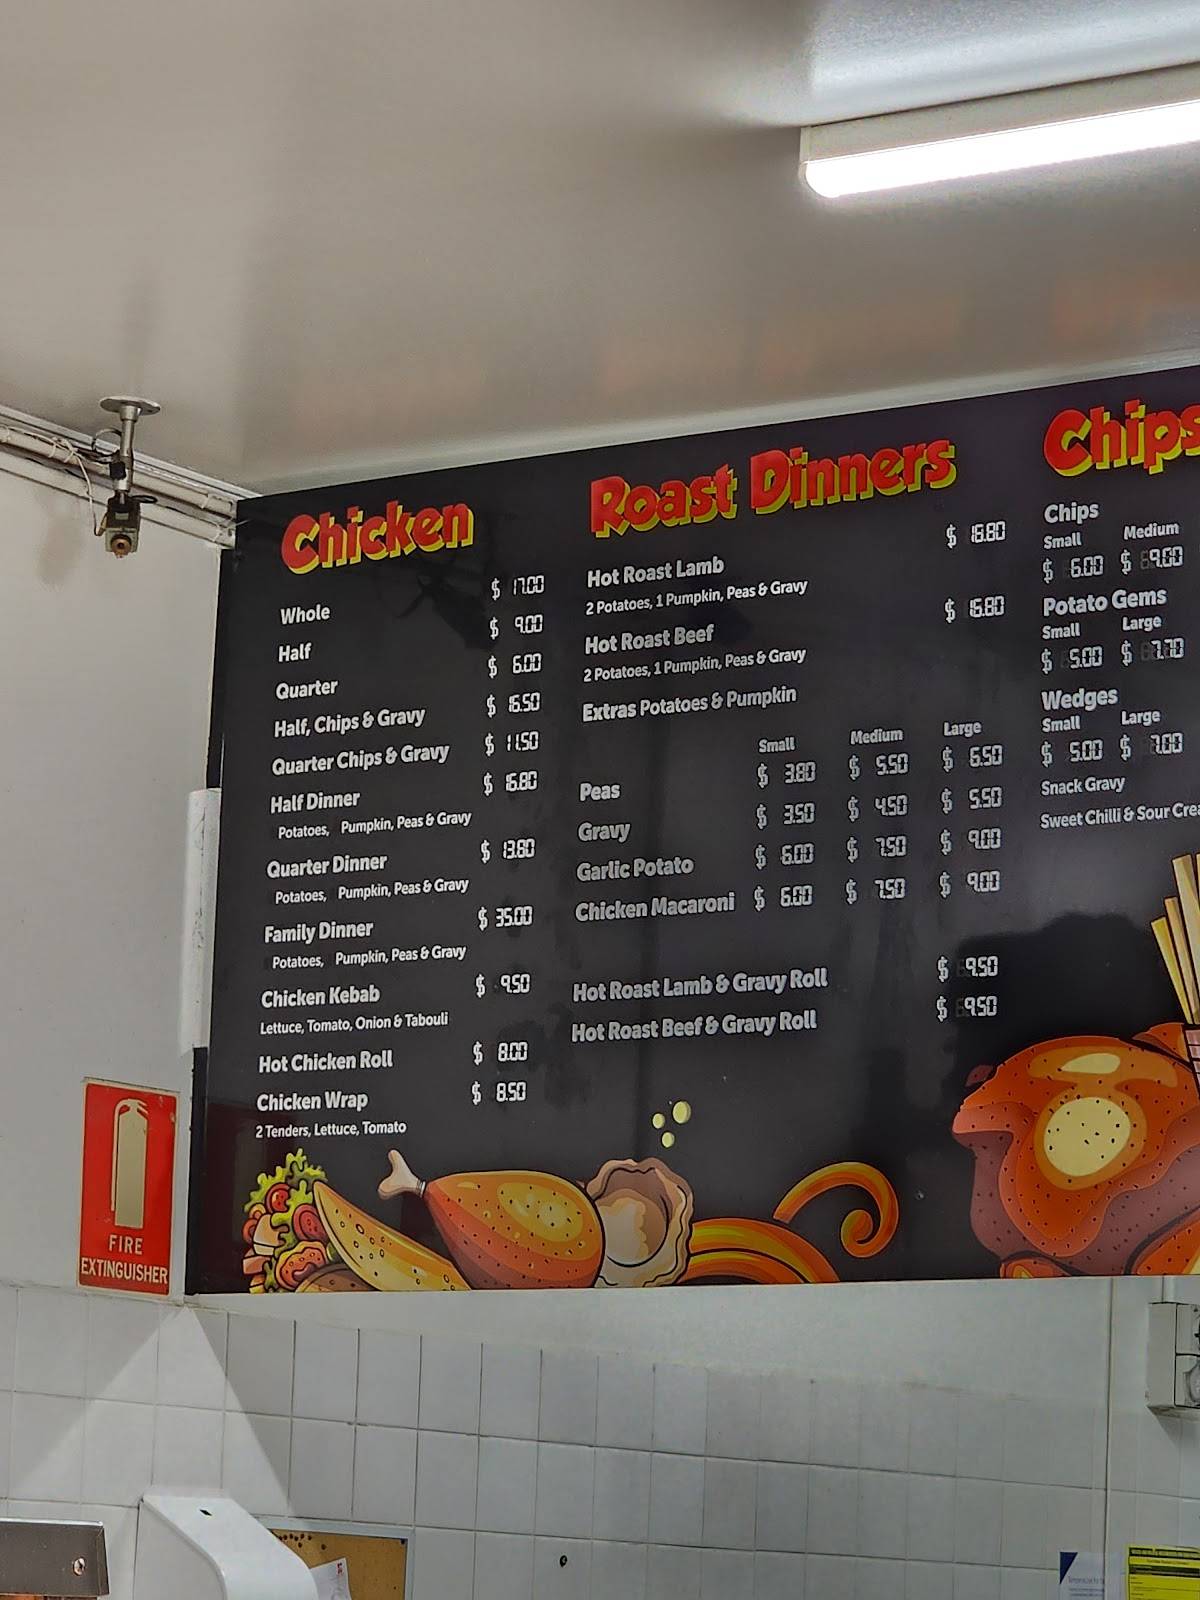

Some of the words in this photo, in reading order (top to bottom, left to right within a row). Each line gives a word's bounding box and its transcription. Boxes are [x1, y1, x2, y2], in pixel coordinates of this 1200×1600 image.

[1044, 400, 1200, 477] Chips
[590, 464, 737, 537] Roast
[750, 440, 957, 514] Dinners
[1045, 502, 1098, 524] Chips
[281, 500, 473, 574] Chicken
[1044, 532, 1081, 549] Small
[1124, 523, 1179, 539] Medium
[1071, 556, 1103, 577] 6.00
[1150, 547, 1182, 567] 9.00
[588, 569, 619, 587] Hot
[624, 563, 672, 583] Roast
[677, 556, 724, 577] Lamb
[514, 575, 544, 594] 17.00
[586, 602, 593, 615] 2
[597, 599, 652, 614] Potatoes,
[656, 594, 663, 607] 1
[667, 589, 723, 606] Pumpkin,
[727, 586, 755, 599] Peas
[758, 583, 768, 596] &
[771, 581, 807, 598] Gravy
[1044, 595, 1107, 616] Potato
[1112, 590, 1166, 609] Gems
[281, 605, 330, 624] Whole
[515, 615, 542, 633] 9.00
[1123, 617, 1161, 631] Large
[586, 636, 617, 654] Hot
[622, 630, 670, 650] Roast
[674, 624, 714, 645] Beef
[1043, 623, 1080, 639] Small
[279, 643, 311, 662] Half
[513, 653, 541, 673] 6.00
[1070, 646, 1102, 668] 5.00
[584, 669, 591, 682] 2
[595, 666, 651, 680] Potatoes,
[654, 662, 661, 674] 1
[664, 656, 722, 674] Pumpkin,
[726, 654, 754, 667] Peas
[757, 651, 766, 664] &
[769, 650, 806, 663] Gravy
[276, 681, 338, 699] Quarter
[1042, 688, 1117, 711] Wedges
[583, 704, 636, 721] Extras
[641, 698, 708, 716] Potatoes
[711, 692, 723, 709] &
[727, 686, 796, 708] Pumpkin
[275, 718, 310, 737] Half,
[315, 715, 359, 734] Chips
[362, 711, 374, 728] &
[378, 709, 425, 727] Gravy
[1043, 716, 1080, 732] Small
[1122, 711, 1160, 726] Large
[851, 729, 902, 744] Medium
[944, 723, 981, 737] Large
[759, 737, 795, 752] Small
[1070, 740, 1102, 761] 5.00
[1151, 733, 1182, 754] 7.00
[273, 757, 334, 775] Quarter
[337, 750, 382, 770] Chips
[386, 747, 397, 764] &
[401, 745, 449, 763] Gravy
[876, 754, 908, 775] 5.50
[970, 745, 1002, 767] 6.50
[785, 762, 815, 783] 3.80
[580, 783, 619, 801] Peas
[1042, 779, 1082, 795] Snack
[1085, 777, 1125, 792] Gravy
[271, 794, 303, 813] Half
[307, 792, 360, 809] Dinner
[876, 795, 907, 815] 4.50
[970, 787, 1001, 809] 5.50
[784, 803, 814, 824] 3.50
[1041, 813, 1083, 828] Sweet
[1085, 808, 1121, 824] Chilli
[1124, 807, 1134, 821] &
[1137, 806, 1170, 820] Sour
[279, 826, 329, 839] Potatoes,
[342, 818, 394, 834] Pumpkin,
[397, 816, 423, 828] Peas
[426, 813, 434, 826] &
[437, 812, 471, 826] Gravy
[579, 823, 630, 842] Gravy
[876, 836, 906, 856] 7.50
[969, 829, 1000, 849] 9.00
[780, 844, 813, 865] 6.00
[267, 860, 329, 878] Quarter
[333, 855, 387, 872] Dinner
[577, 861, 630, 881] Garlic
[634, 857, 693, 876] Potato
[276, 891, 326, 904] Potatoes,
[339, 884, 391, 900] Pumpkin,
[394, 882, 420, 895] Peas
[423, 880, 432, 892] &
[434, 879, 469, 893] Gravy
[875, 879, 905, 898] 7.50
[968, 871, 1000, 892] 9.00
[576, 897, 647, 921] Chicken
[652, 892, 734, 916] Macaroni
[781, 886, 812, 906] 6.00
[496, 906, 532, 927] 35.00
[265, 924, 315, 944] Family
[319, 922, 373, 939] Dinner
[273, 956, 323, 968] Potatoes,
[336, 950, 388, 966] Pumpkin,
[392, 949, 418, 961] Peas
[421, 947, 429, 959] &
[432, 946, 466, 960] Gravy
[966, 956, 998, 976] 9.50
[501, 974, 530, 993] 9.50
[574, 983, 606, 1001] Hot
[610, 980, 659, 999] Roast
[664, 976, 713, 996] Lamb
[716, 974, 729, 993] &
[733, 973, 787, 994] Gravy
[791, 968, 828, 988] Roll
[262, 989, 325, 1008] Chicken
[330, 985, 379, 1004] Kebab
[965, 996, 997, 1016] 9.50
[261, 1023, 304, 1034] Lettuce,
[307, 1019, 352, 1032] Tomato,
[356, 1016, 391, 1029] Onion
[394, 1015, 402, 1027] &
[405, 1012, 448, 1026] Tabouli
[572, 1024, 604, 1042] Hot
[609, 1021, 658, 1040] Roast
[662, 1017, 703, 1037] Beef
[705, 1016, 719, 1034] &
[722, 1015, 776, 1036] Gravy
[780, 1010, 816, 1030] Roll
[259, 1056, 288, 1072] Hot
[292, 1053, 356, 1071] Chicken
[360, 1050, 392, 1068] Roll
[498, 1042, 527, 1061] 8.00
[257, 1093, 321, 1111] Chicken
[325, 1091, 368, 1111] Wrap
[497, 1082, 526, 1101] 8.50
[256, 1126, 262, 1138] 2
[265, 1125, 311, 1137] Tenders,
[315, 1124, 359, 1135] Lettuce,
[362, 1121, 406, 1134] Tomato
[109, 1235, 143, 1255] FIRE
[81, 1257, 168, 1284] EXTINGUISHER
